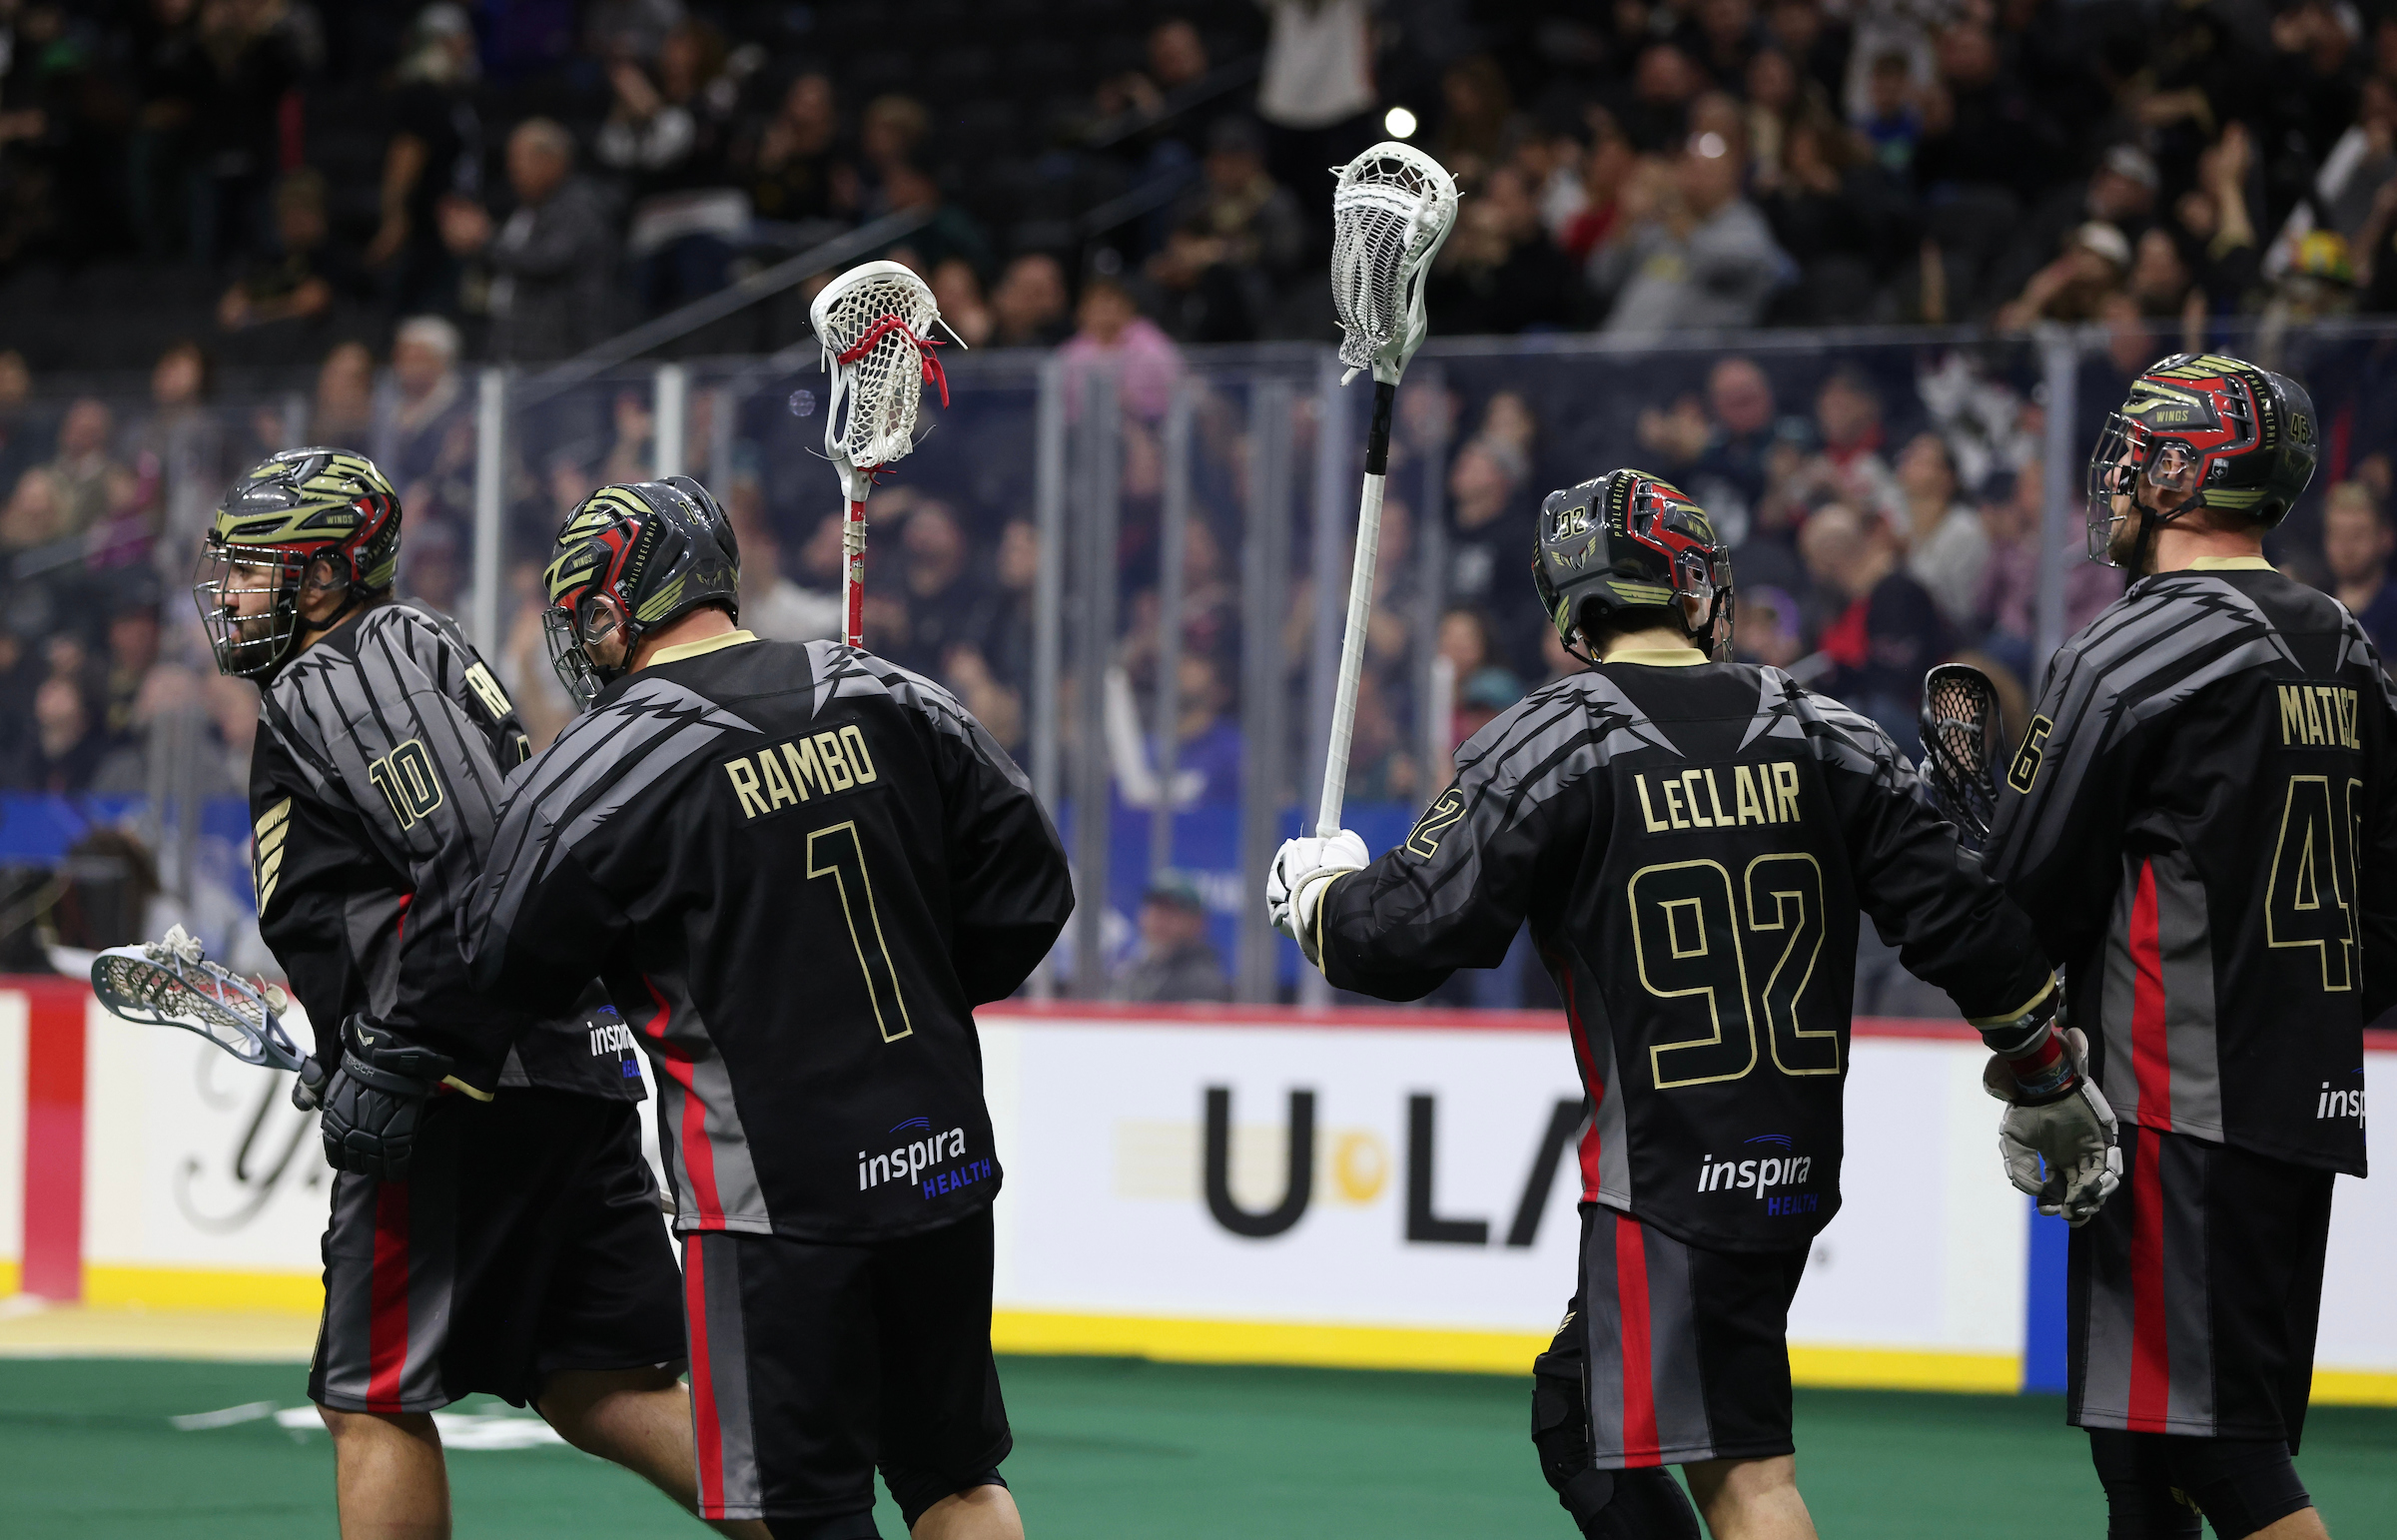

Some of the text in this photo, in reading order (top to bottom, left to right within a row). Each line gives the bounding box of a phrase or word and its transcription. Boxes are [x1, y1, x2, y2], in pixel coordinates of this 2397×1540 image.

[2156, 409, 2189, 422] WINGS
[2290, 413, 2309, 446] 46
[326, 514, 354, 524] WINGS
[678, 501, 698, 525] 1
[1560, 505, 1586, 540] 92
[571, 553, 593, 569] WINGS
[628, 520, 658, 589] PHILADELPHIA
[370, 738, 443, 831] 10
[724, 724, 877, 819] RAMBO
[807, 820, 914, 1044] 1
[1627, 852, 1841, 1090] 92
[2316, 1082, 2366, 1130] insp
[858, 1127, 966, 1191] inspira
[922, 1157, 992, 1199] HEALTH
[1697, 1154, 1812, 1200] inspira
[1768, 1193, 1818, 1216] HEALTH
